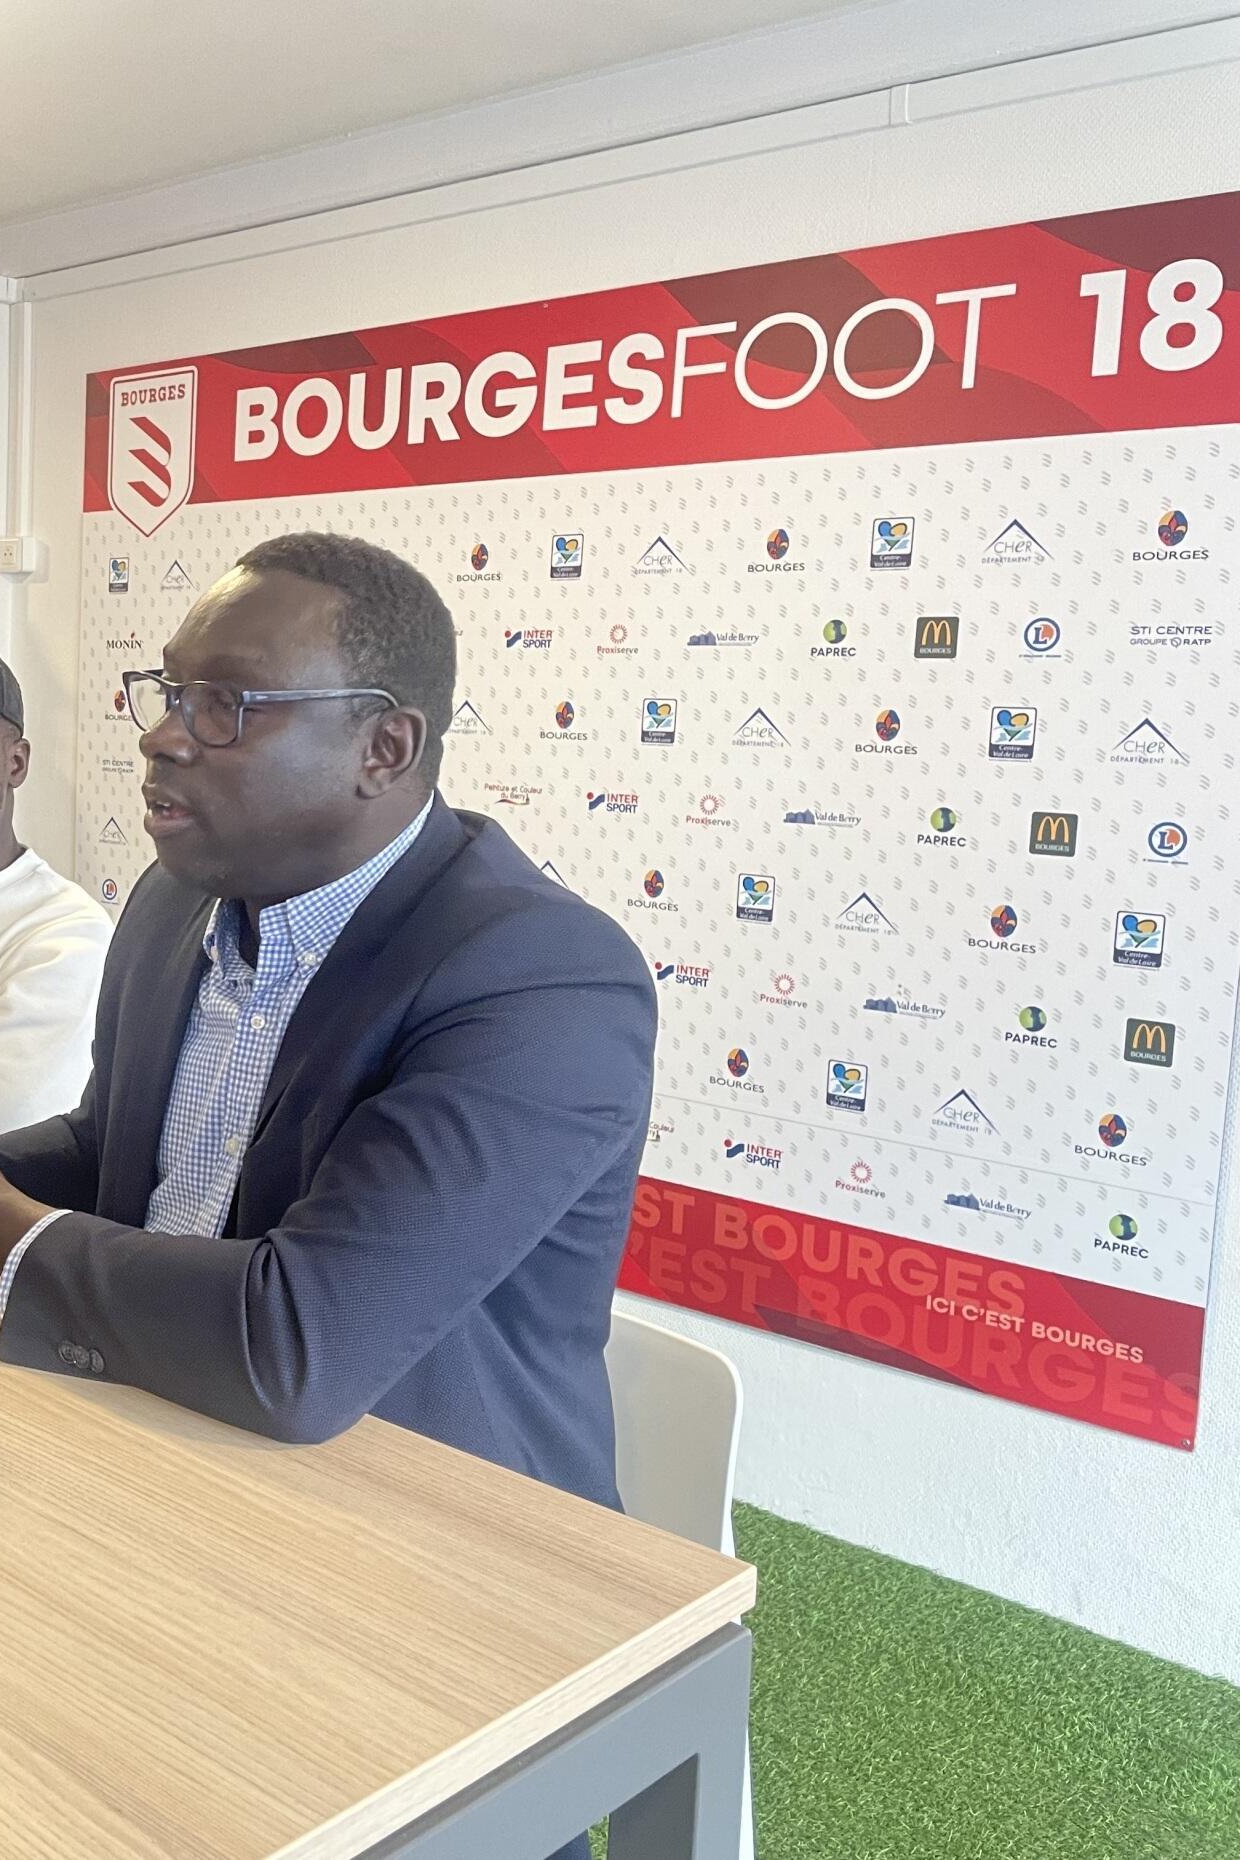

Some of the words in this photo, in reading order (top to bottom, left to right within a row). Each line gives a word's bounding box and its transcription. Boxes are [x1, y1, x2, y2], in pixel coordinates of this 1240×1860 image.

[1080, 258, 1224, 377] 18
[121, 384, 186, 407] BOURGES
[1133, 550, 1209, 561] BOURGES
[748, 563, 805, 573] BOURGES
[457, 572, 501, 582] BOURGES
[523, 630, 553, 639] INTER
[717, 632, 727, 641] Val
[728, 633, 737, 641] de
[1131, 626, 1151, 635] STI
[1156, 626, 1212, 635] CENTRE
[523, 639, 552, 648] SPORT
[1130, 638, 1167, 646] GROUPE
[597, 646, 638, 654] Proxiserve
[811, 647, 856, 657] PAPREC
[540, 731, 587, 741] BOURGES
[855, 744, 917, 755] BOURGES
[607, 793, 638, 804] INTER
[606, 803, 638, 813] SPORT
[686, 816, 731, 826] Proxiserve
[815, 812, 827, 822] Val
[828, 813, 837, 822] de
[839, 814, 861, 825] Berry
[917, 834, 966, 847] PAPREC
[628, 899, 678, 912] BOURGES
[968, 938, 1036, 954] BOURGES
[677, 964, 710, 977] INTER
[676, 974, 708, 987] SPORT
[760, 994, 808, 1008] Proxiserve
[897, 1001, 910, 1011] Val
[911, 1003, 920, 1012] de
[922, 1004, 946, 1018] Berry
[1005, 1032, 1058, 1049] PAPREC
[1130, 1051, 1167, 1062] BOURGES
[710, 1076, 765, 1093] BOURGES
[747, 1144, 782, 1159] INTER
[1074, 1145, 1147, 1167] BOURGES
[746, 1154, 781, 1169] SPORT
[835, 1180, 886, 1199] Proxiserve
[980, 1198, 993, 1209] Val
[994, 1201, 1005, 1211] de
[1006, 1203, 1032, 1219] Berry
[1094, 1238, 1149, 1259] PAPREC
[714, 1203, 1025, 1315] BOURGES
[926, 1295, 954, 1316] ICI
[962, 1304, 1025, 1333] C'EST
[1031, 1321, 1144, 1364] BOURGES
